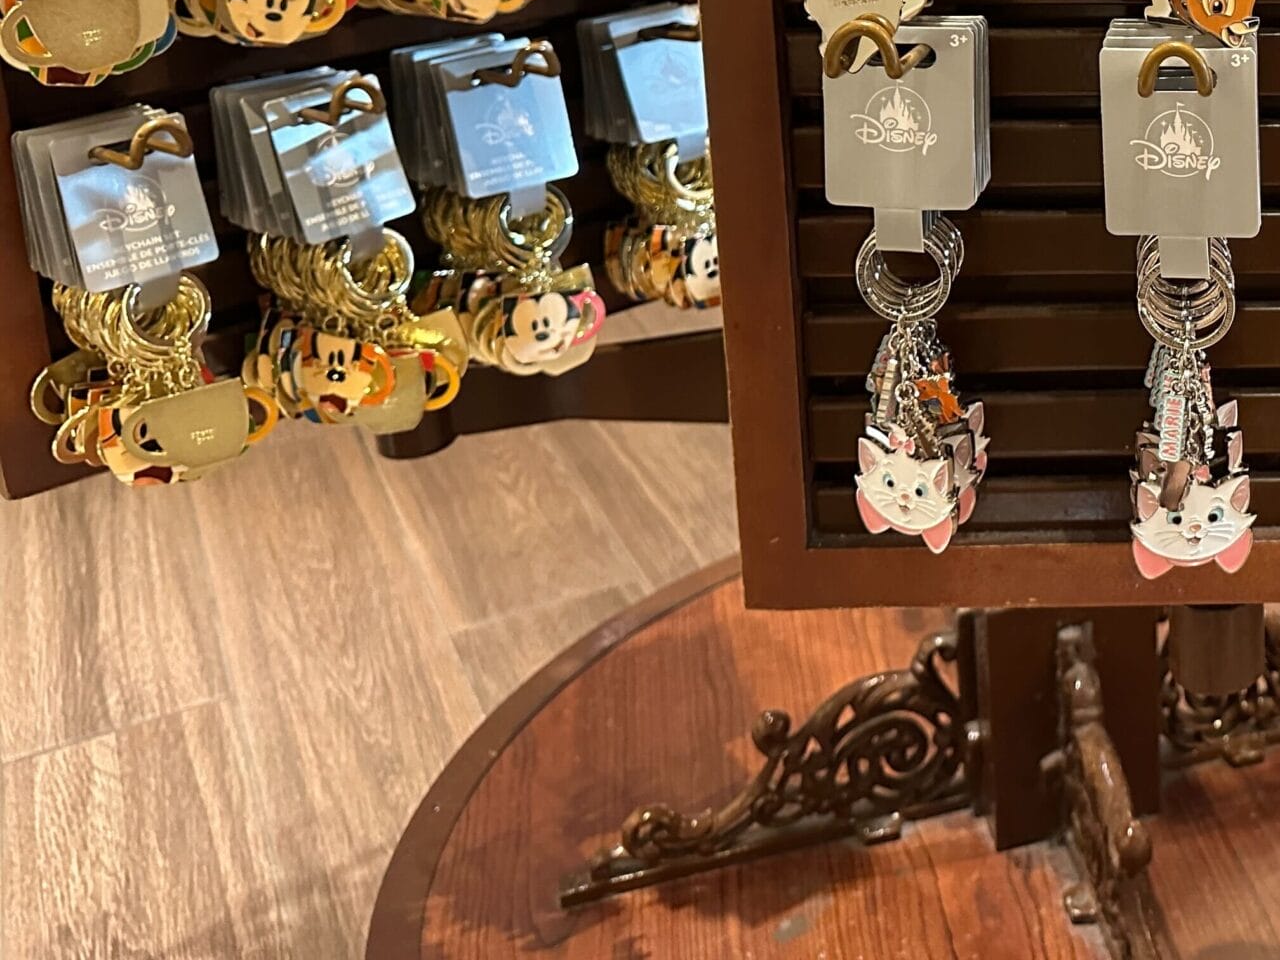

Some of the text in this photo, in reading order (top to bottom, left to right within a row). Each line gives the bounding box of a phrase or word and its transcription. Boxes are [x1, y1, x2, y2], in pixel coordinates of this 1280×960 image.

[949, 34, 968, 48] 3+
[1231, 53, 1250, 68] 3+
[1161, 398, 1183, 456] MARIE
